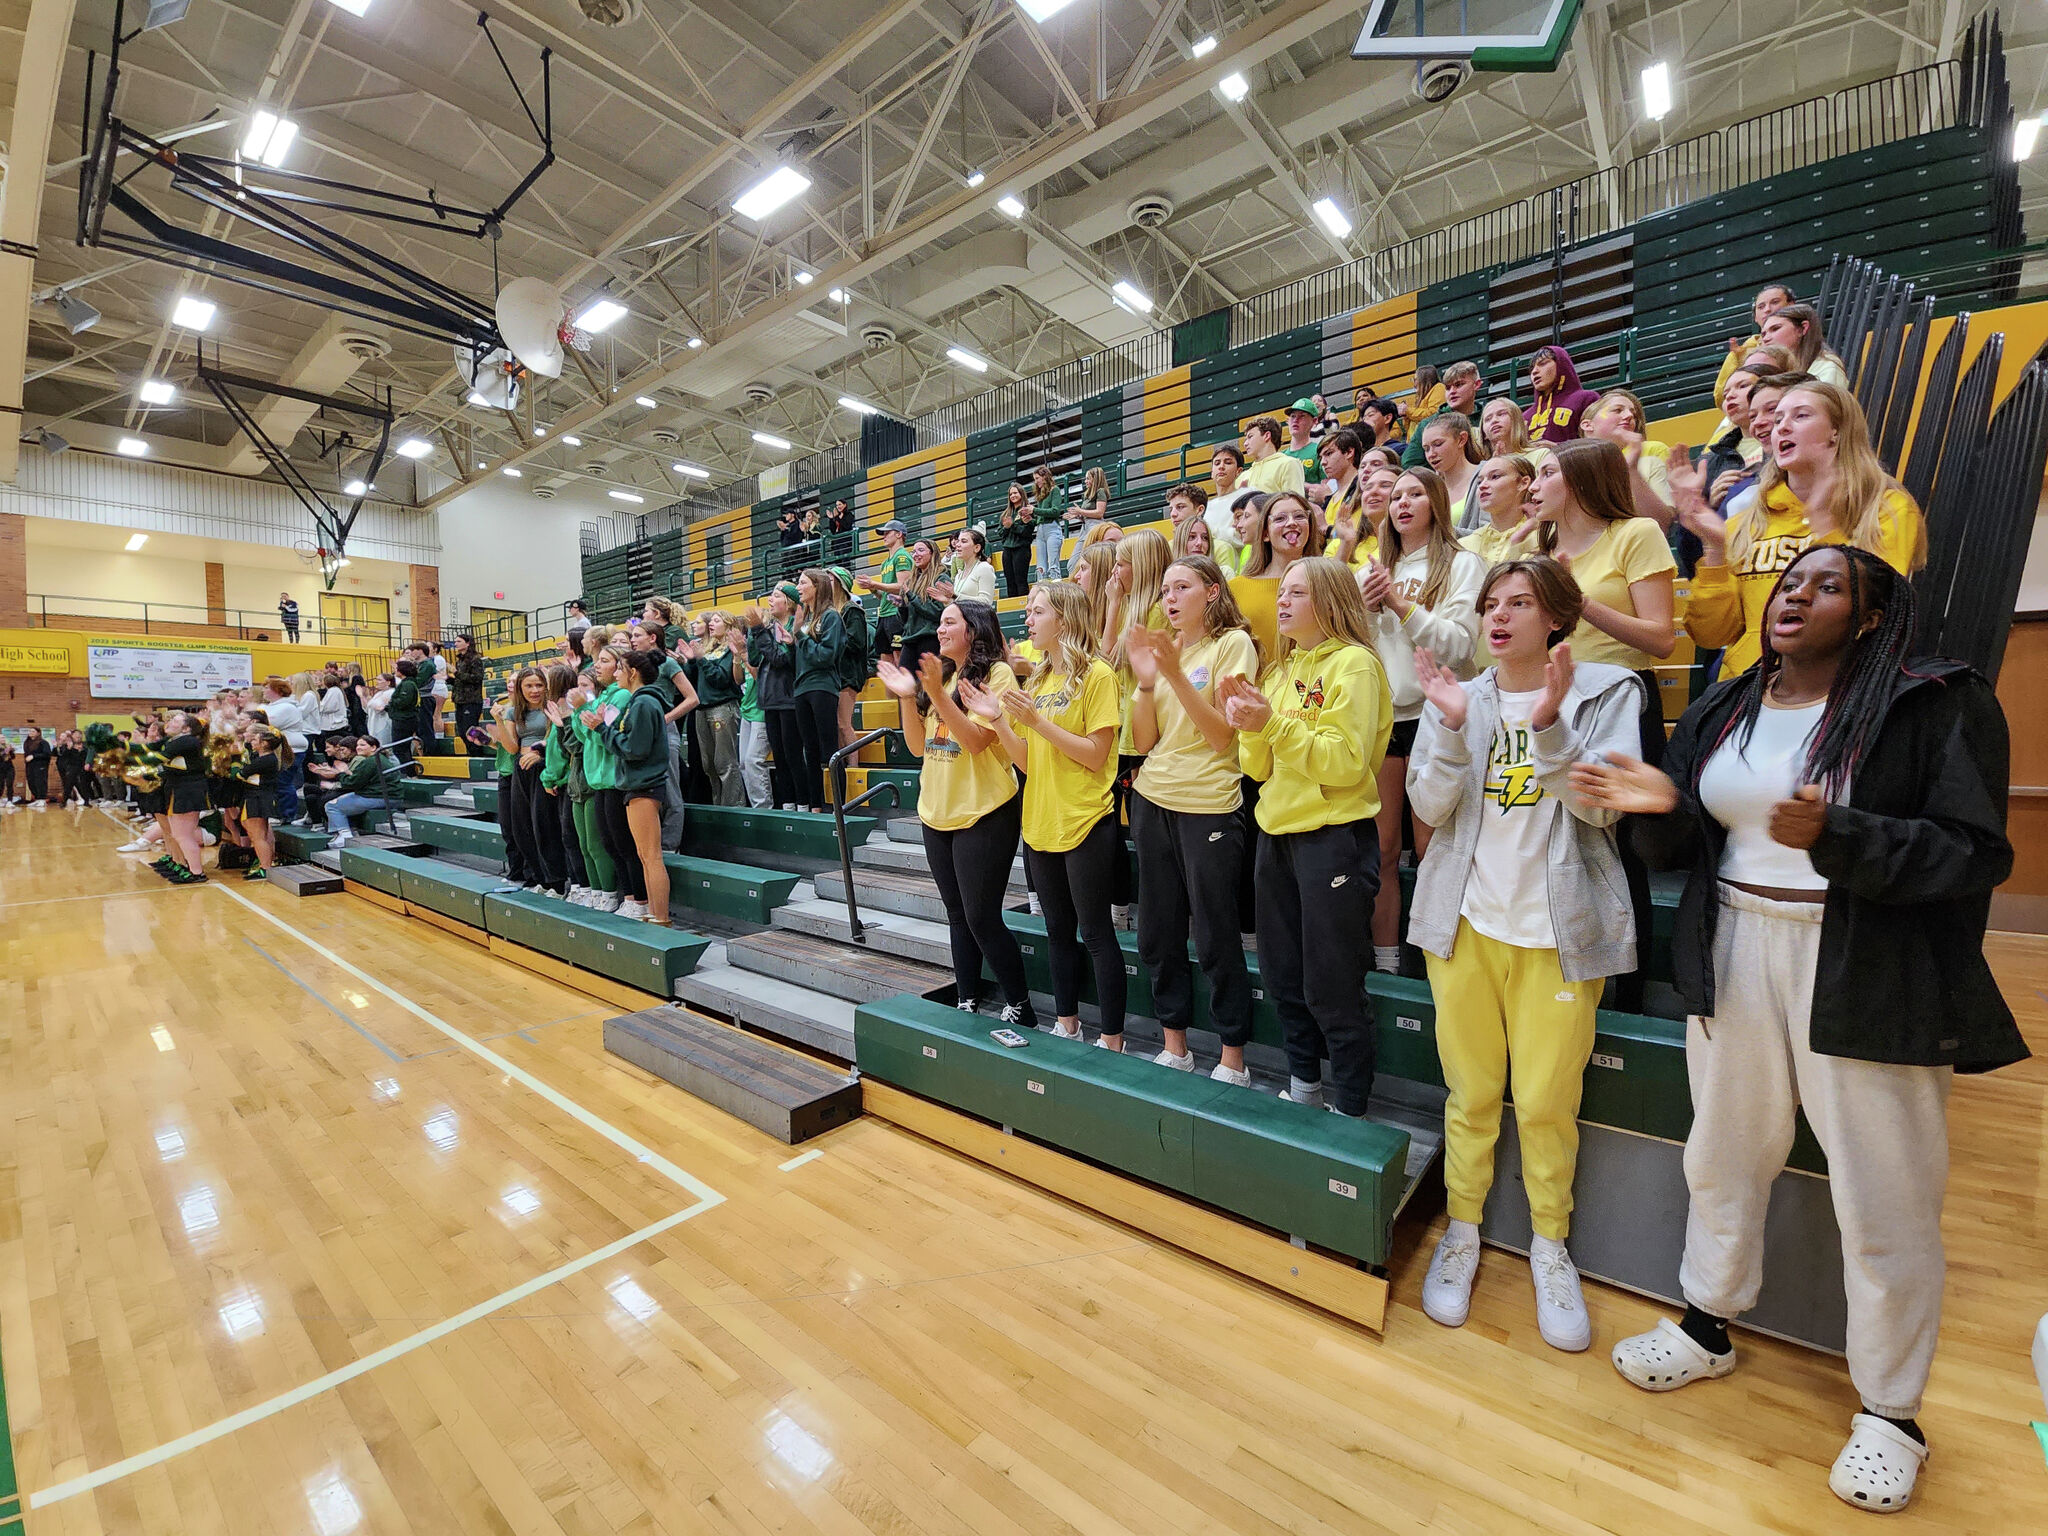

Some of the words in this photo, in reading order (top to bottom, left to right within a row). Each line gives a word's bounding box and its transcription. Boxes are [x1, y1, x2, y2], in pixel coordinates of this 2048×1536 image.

[28, 649, 66, 661] School
[1402, 1019, 1415, 1029] 50
[1599, 1056, 1613, 1067] 51
[1031, 1082, 1040, 1092] 37
[1335, 1182, 1349, 1195] 39
